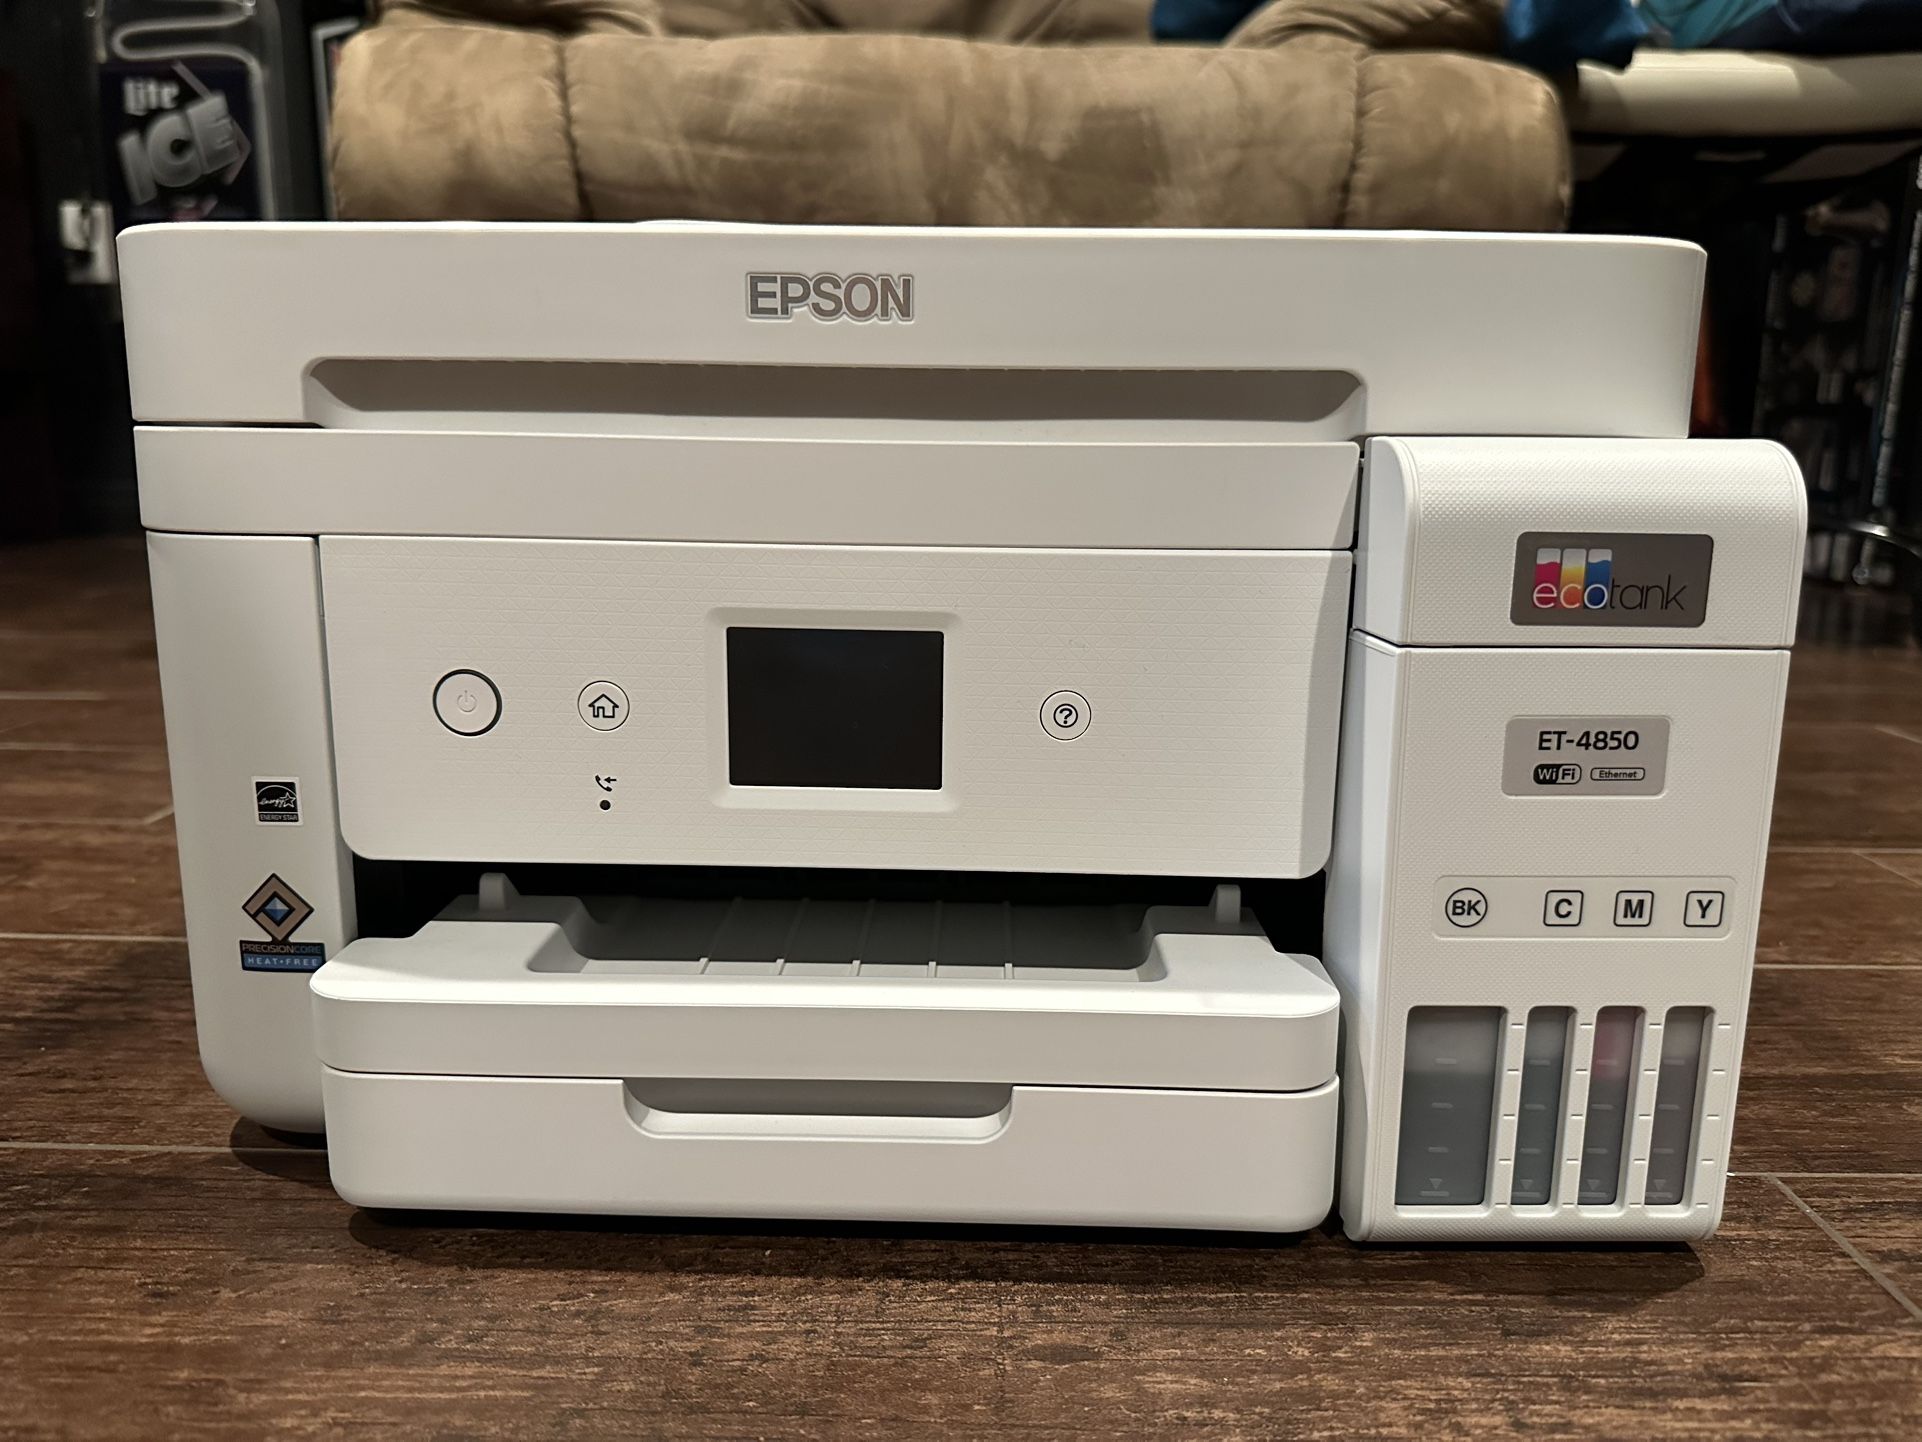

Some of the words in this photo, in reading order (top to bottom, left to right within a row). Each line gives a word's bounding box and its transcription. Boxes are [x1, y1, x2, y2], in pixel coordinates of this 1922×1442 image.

[118, 91, 241, 206] ICE
[748, 274, 913, 319] EPSON
[1533, 574, 1687, 611] ecotank
[1538, 730, 1640, 751] ET-4850
[1598, 769, 1638, 779] Ethernet
[1451, 900, 1482, 917] BK
[1554, 898, 1573, 919] C
[1622, 899, 1645, 919] M
[1696, 899, 1714, 919] Y
[242, 943, 322, 954] PRECISIONCORE
